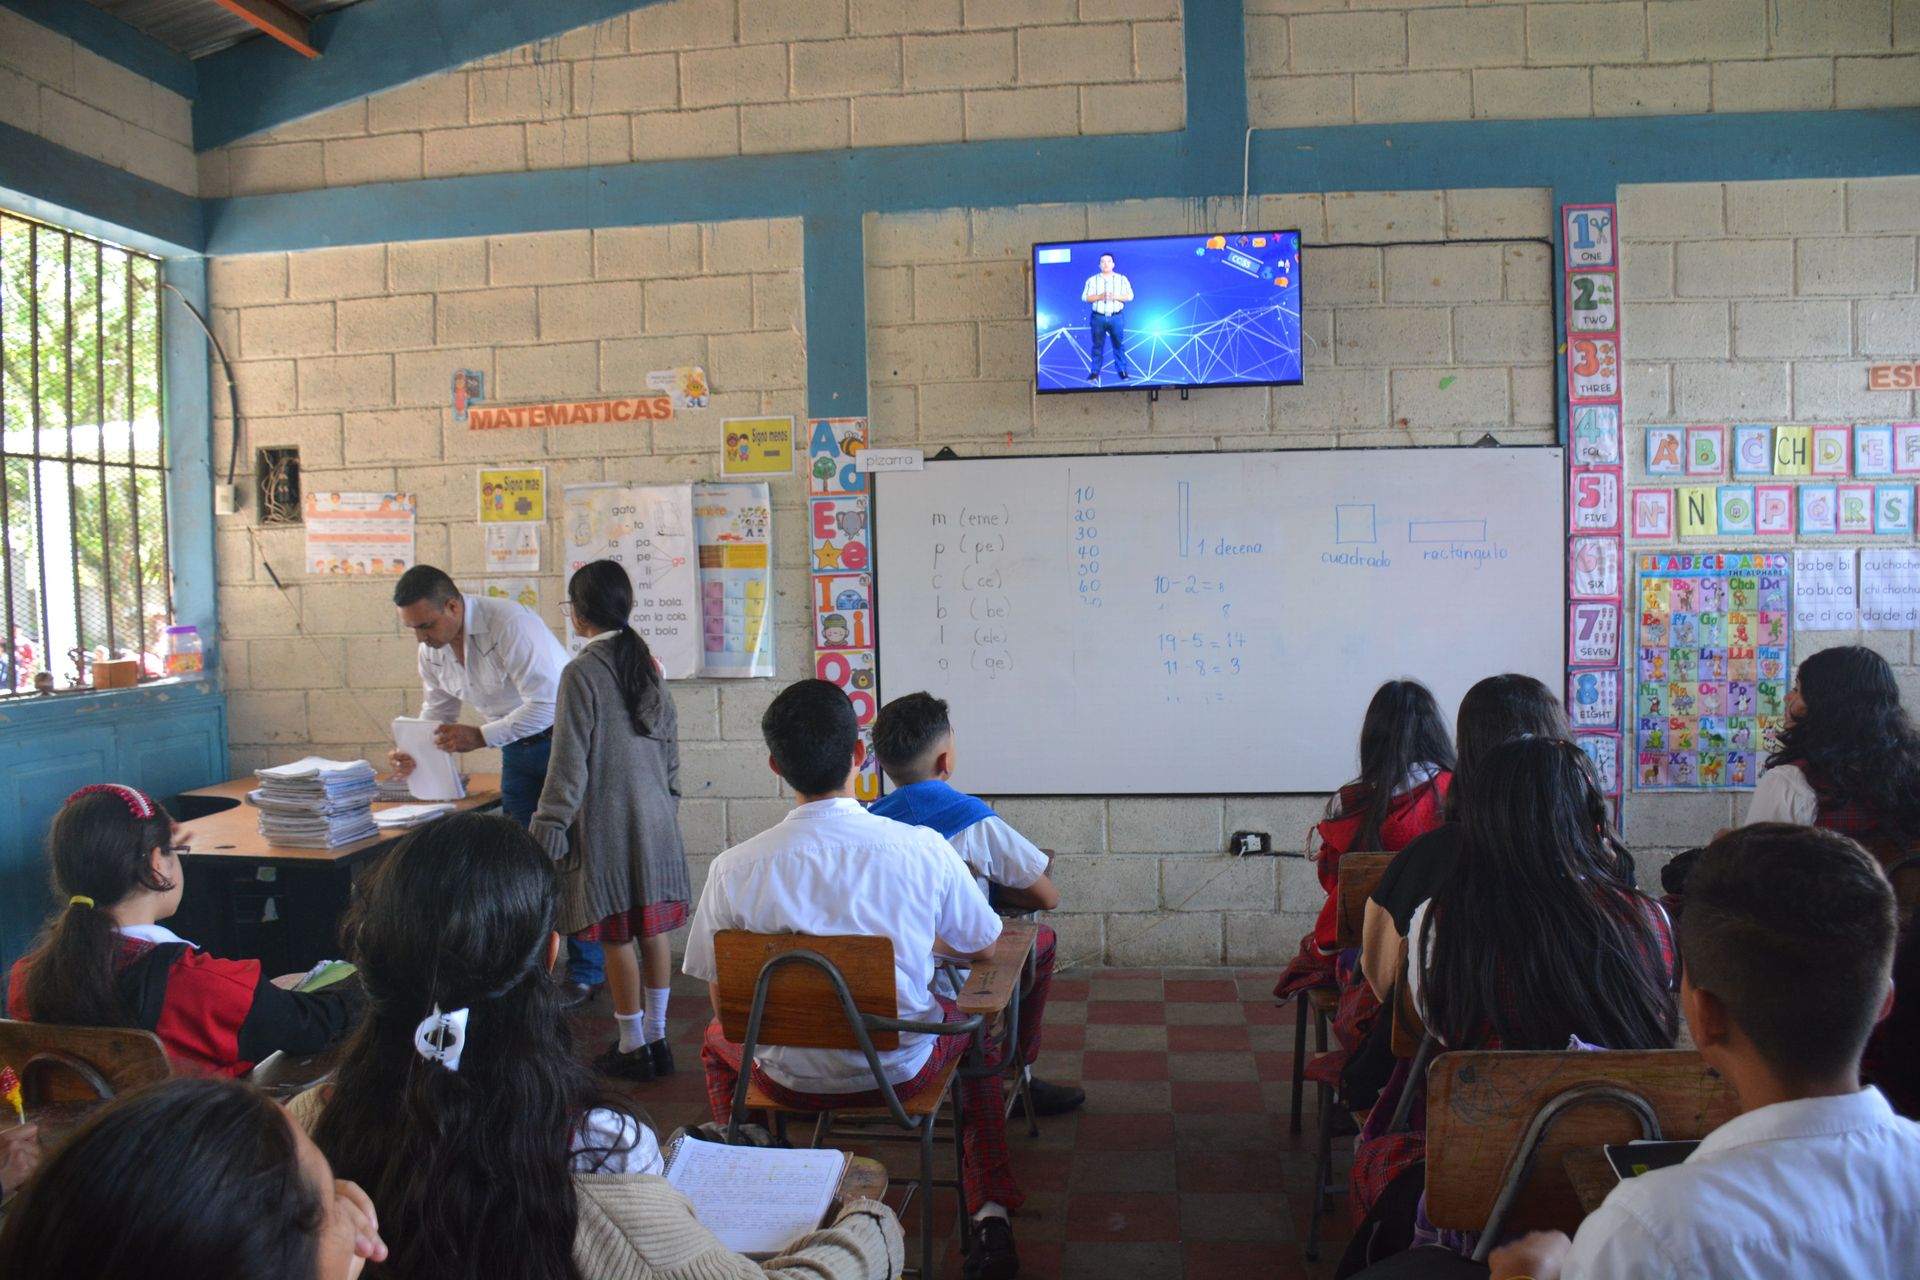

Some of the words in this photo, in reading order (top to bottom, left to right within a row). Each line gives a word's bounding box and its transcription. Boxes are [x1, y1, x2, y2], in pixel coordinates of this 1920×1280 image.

[1573, 214, 1596, 249] 1
[1581, 252, 1603, 262] ONE
[1574, 277, 1598, 311] 2
[1582, 316, 1607, 325] TWO
[1574, 340, 1600, 377] 3
[1580, 384, 1612, 393] THREE
[470, 398, 672, 430] MATEMATICAS
[1575, 408, 1600, 445] 4
[752, 429, 768, 446] Signo
[769, 431, 789, 442] menos
[811, 420, 840, 459] A
[1651, 437, 1680, 466] A
[1695, 438, 1717, 466] B
[1742, 437, 1763, 465] C
[1777, 437, 1806, 466] CH
[1819, 438, 1842, 465] D
[1867, 439, 1884, 466] E
[866, 456, 913, 470] pizarra
[840, 463, 866, 492] a
[504, 477, 523, 495] Signo
[1578, 476, 1601, 509] 5
[1074, 486, 1094, 504] 10
[612, 505, 636, 516] gato
[931, 514, 948, 526] m
[960, 504, 1009, 528] (eme)
[1074, 509, 1096, 522] 20
[1637, 500, 1664, 528] N
[1724, 498, 1749, 524] O
[1764, 498, 1786, 525] P
[1807, 498, 1830, 522] Q
[1844, 497, 1864, 522] R
[1884, 497, 1903, 522] S
[634, 520, 645, 529] to
[813, 501, 836, 540] E
[1585, 514, 1607, 523] FIVE
[1075, 526, 1098, 540] 30
[608, 539, 619, 549] la
[636, 539, 651, 550] pa
[1078, 544, 1100, 559] 40
[1198, 538, 1205, 555] 1
[1215, 537, 1263, 556] decena
[637, 552, 652, 565] pe
[672, 556, 686, 568] ga
[841, 540, 868, 570] e
[934, 543, 946, 570] p
[1321, 546, 1392, 568] cuadrado
[1576, 543, 1598, 574] 6
[1641, 555, 1660, 571] EL
[1816, 556, 1833, 571] be
[1838, 557, 1850, 571] bi
[1865, 562, 1880, 571] cu
[639, 580, 652, 589] mi
[1080, 579, 1101, 592] 60
[1588, 580, 1605, 589] SIX
[1643, 578, 1661, 591] Aa
[1673, 578, 1690, 591] Bb
[1700, 578, 1717, 590] Cc
[1760, 577, 1779, 590] Dd
[1816, 581, 1833, 596] bu
[1837, 586, 1853, 596] ca
[818, 576, 834, 613] I
[643, 598, 653, 608] la
[936, 595, 948, 619] b
[633, 613, 651, 623] con
[654, 612, 664, 623] la
[1642, 613, 1660, 625] Ee
[1798, 612, 1815, 622] ce
[1820, 609, 1831, 622] ci
[1837, 611, 1853, 622] co
[1863, 607, 1880, 621] da
[1883, 607, 1901, 621] de
[1906, 607, 1918, 621] di
[655, 626, 679, 637] bola
[853, 611, 865, 648] i
[1578, 610, 1602, 641] 7
[1159, 633, 1176, 651] 19
[1580, 648, 1612, 657] SEVEN
[1669, 648, 1689, 660] Kk
[1758, 647, 1780, 660] Mm
[816, 651, 851, 689] O
[1576, 674, 1599, 705] 8
[1640, 683, 1658, 695] Nn
[1698, 682, 1718, 695] Oo
[1728, 682, 1747, 696] Pp
[1757, 682, 1776, 697] Qq
[1580, 710, 1612, 719] EIGHT
[1640, 718, 1658, 730] Rr
[1670, 717, 1686, 730] Ss
[1699, 718, 1714, 730] Tt
[1728, 716, 1747, 730] Uu
[1669, 752, 1688, 765] Xx
[1699, 752, 1717, 767] Yy
[1727, 752, 1745, 764] Zz
